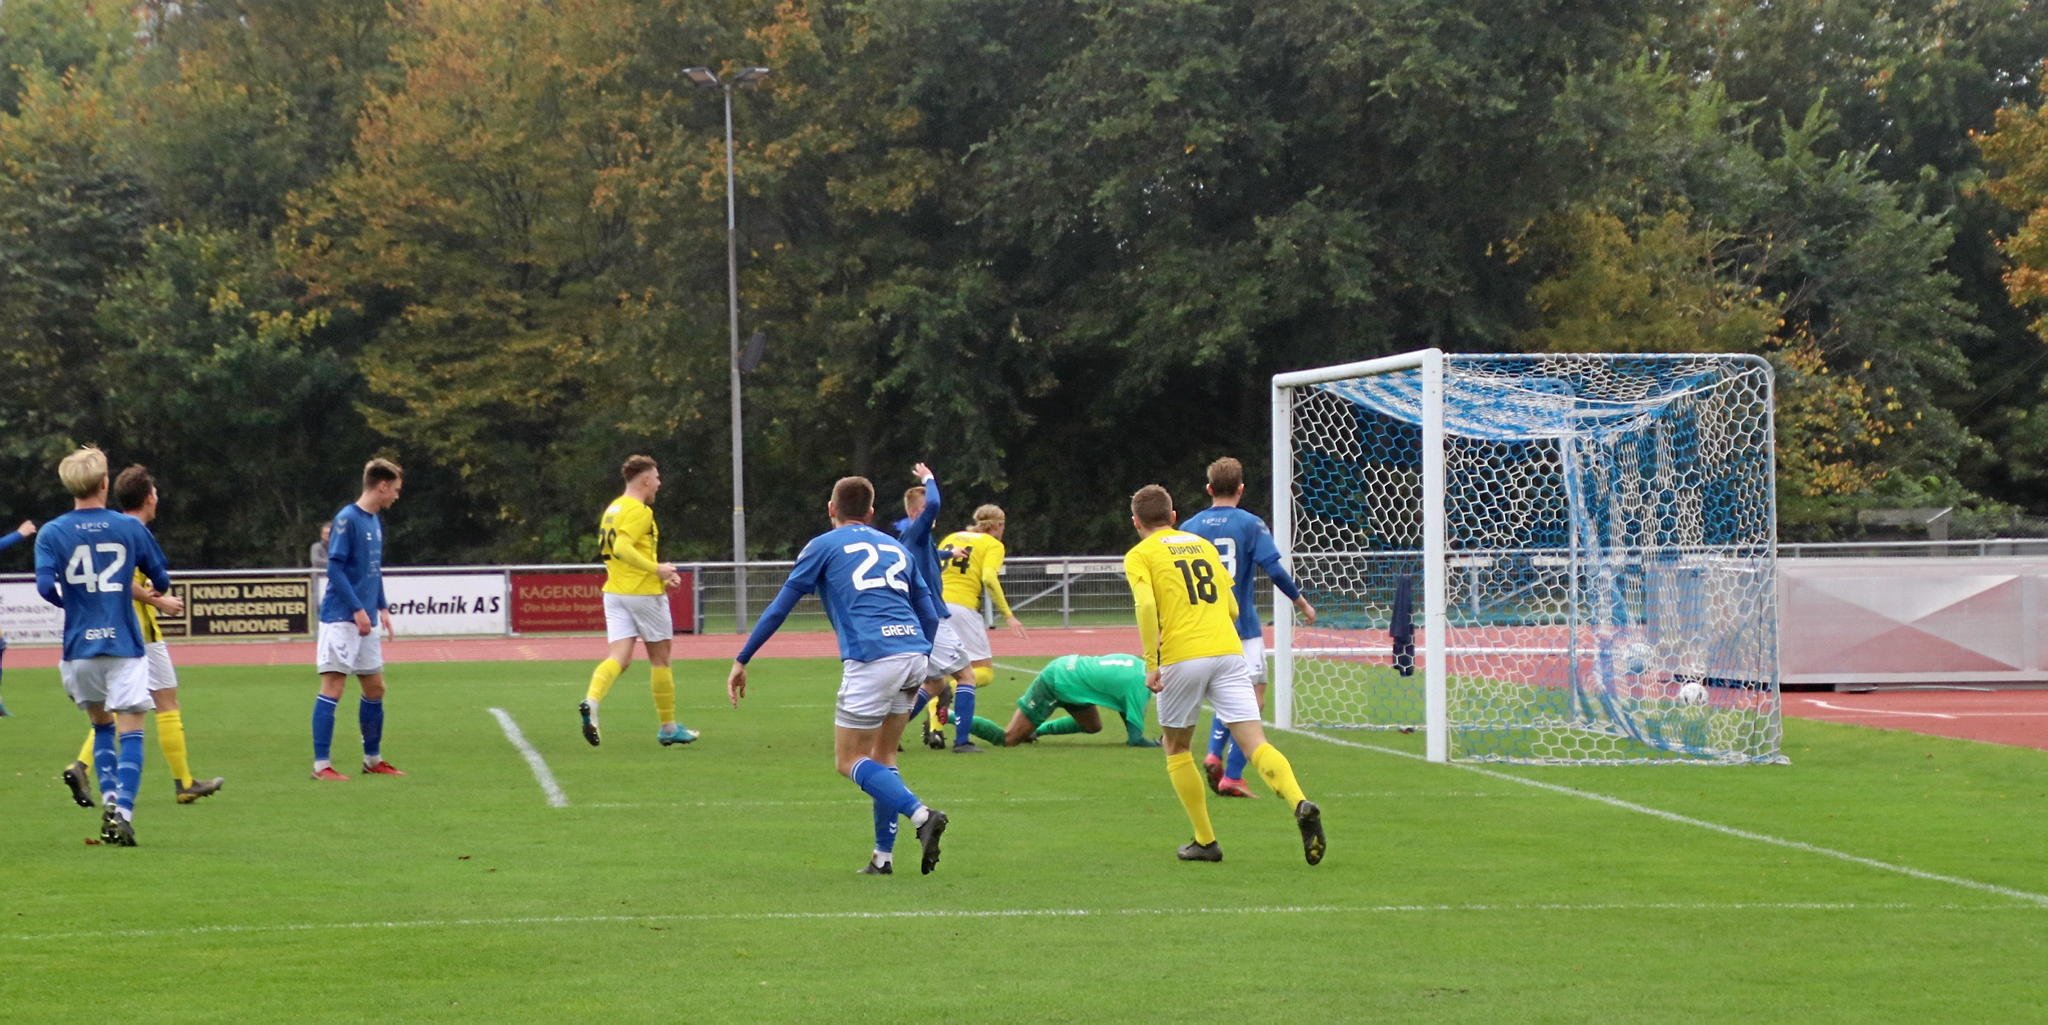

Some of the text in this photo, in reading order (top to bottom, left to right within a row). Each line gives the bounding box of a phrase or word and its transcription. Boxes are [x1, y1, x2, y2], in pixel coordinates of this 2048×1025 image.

[1168, 545, 1205, 555] DUPONT
[65, 543, 127, 592] 42
[843, 541, 909, 592] 22
[1174, 559, 1218, 605] 18
[193, 585, 239, 599] KNUD
[243, 584, 305, 598] LARSEN
[193, 602, 306, 616] BYGGECENTER
[209, 619, 290, 633] HVIDOVRE
[881, 625, 917, 637] GREVE
[85, 627, 117, 640] GREVE
